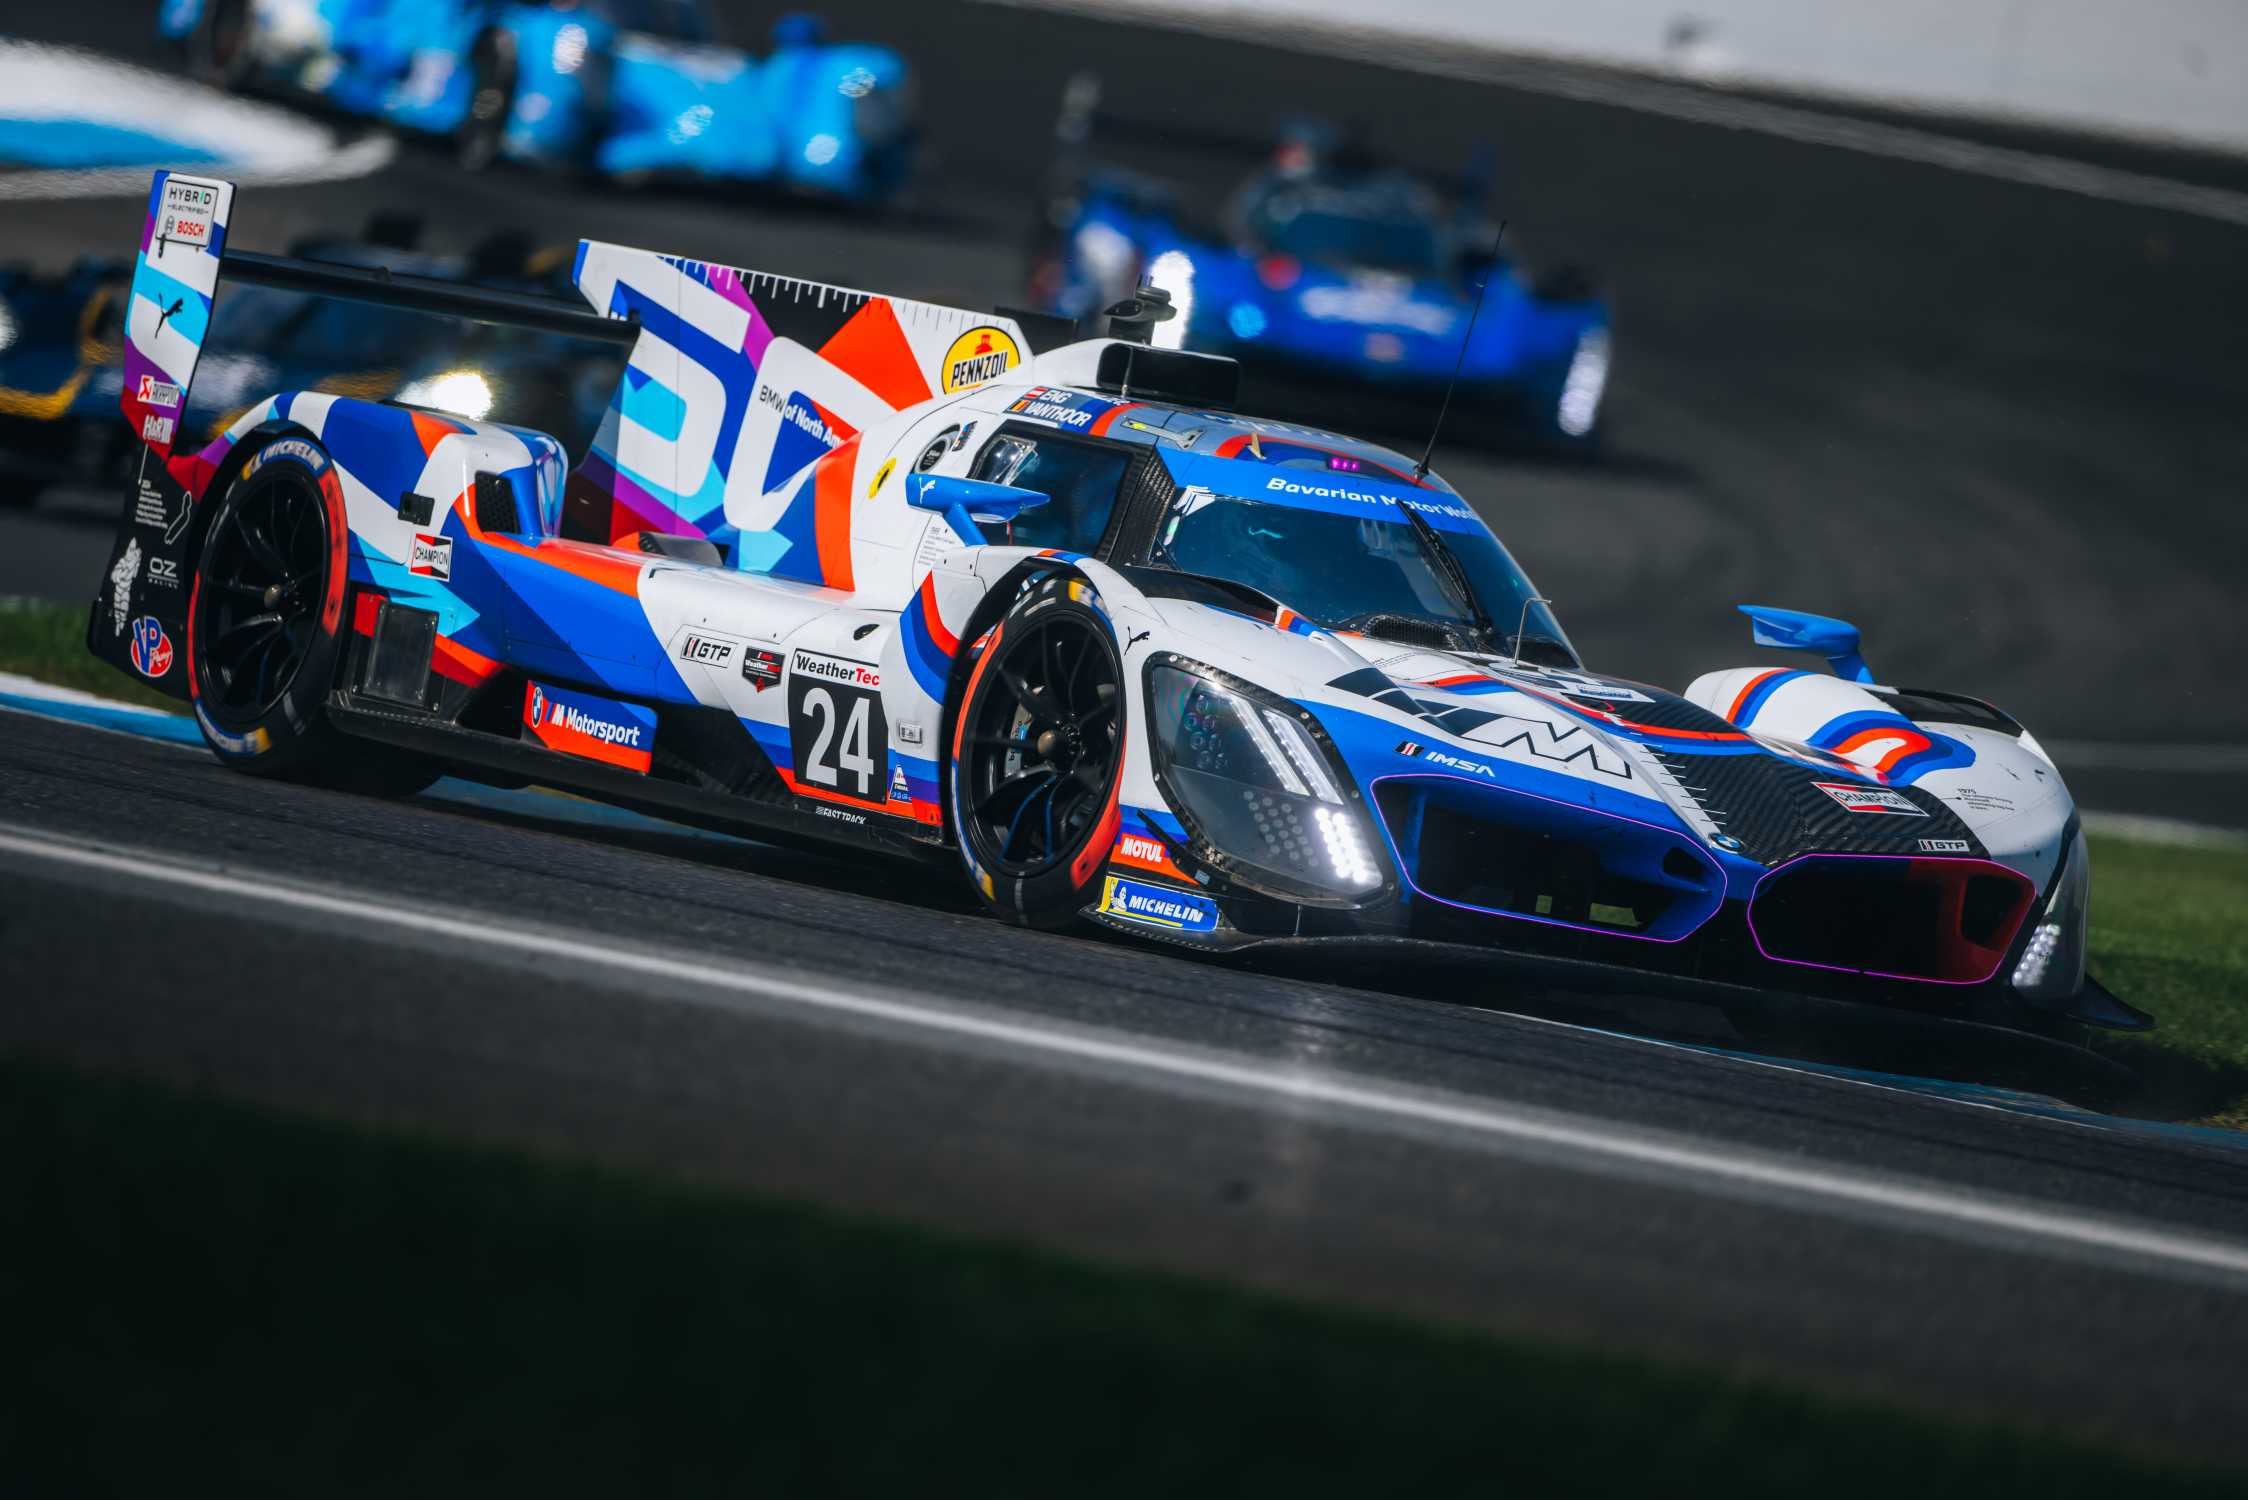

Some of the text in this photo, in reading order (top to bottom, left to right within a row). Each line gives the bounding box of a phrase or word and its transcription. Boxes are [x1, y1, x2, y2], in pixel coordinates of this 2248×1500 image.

[169, 186, 212, 205] HYBRID
[176, 220, 205, 236] BOSCH
[950, 350, 1009, 388] PENNZOIL
[1040, 388, 1073, 404] ENG
[759, 385, 788, 413] BMW
[784, 404, 799, 422] of
[795, 406, 825, 440] North
[1023, 402, 1092, 427] VANTHOOR
[262, 439, 325, 471] MICHELIN
[1266, 477, 1377, 504] Bavarian
[415, 546, 449, 567] CHAMPION
[132, 616, 162, 674] VP
[697, 642, 732, 661] GTP
[565, 706, 640, 746] Motorsport
[802, 687, 874, 795] 24
[1425, 751, 1496, 778] IMSA
[1120, 838, 1163, 863] MOTUL
[1934, 841, 1966, 850] GTP
[1128, 895, 1204, 923] MICHELIN
